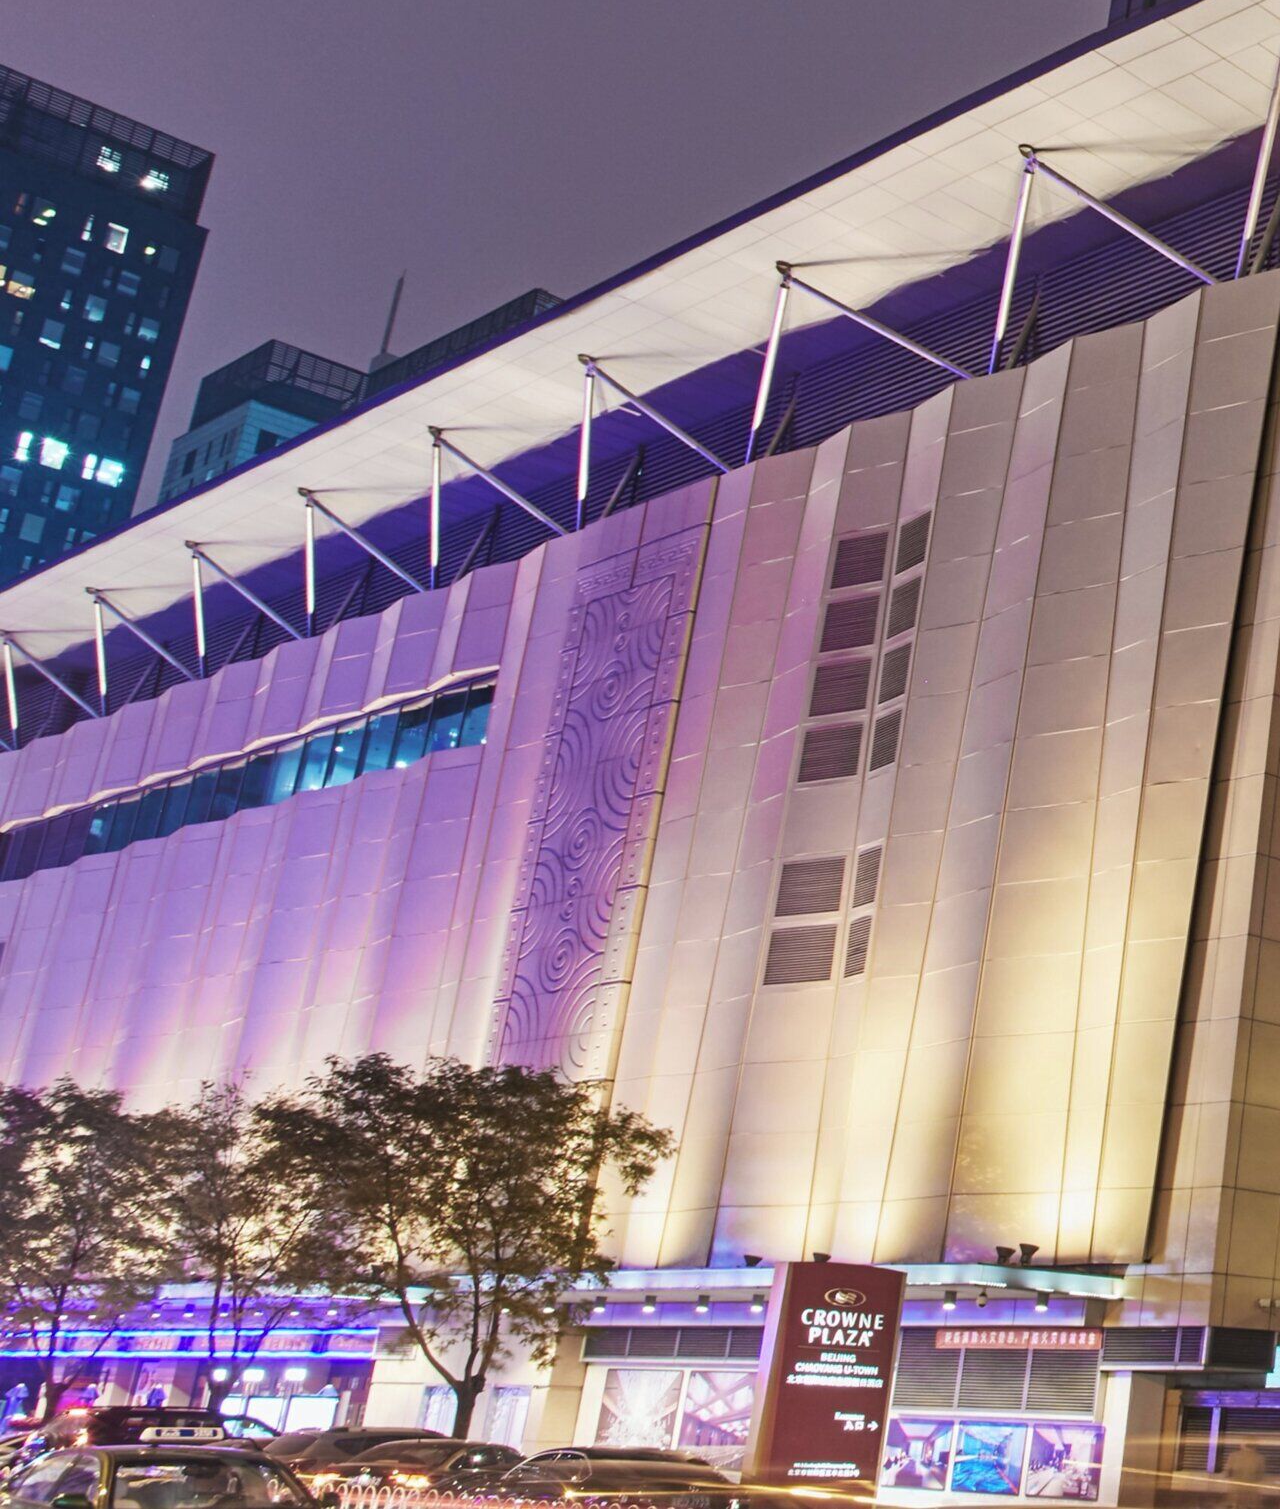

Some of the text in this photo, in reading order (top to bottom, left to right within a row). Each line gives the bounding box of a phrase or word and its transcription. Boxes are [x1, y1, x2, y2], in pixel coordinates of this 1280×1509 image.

[801, 1308, 884, 1330] CROWNE
[808, 1327, 871, 1347] PLAZA
[820, 1352, 857, 1363] BEIJING
[844, 1365, 879, 1376] U-TOWN
[843, 1420, 865, 1431] 入口
